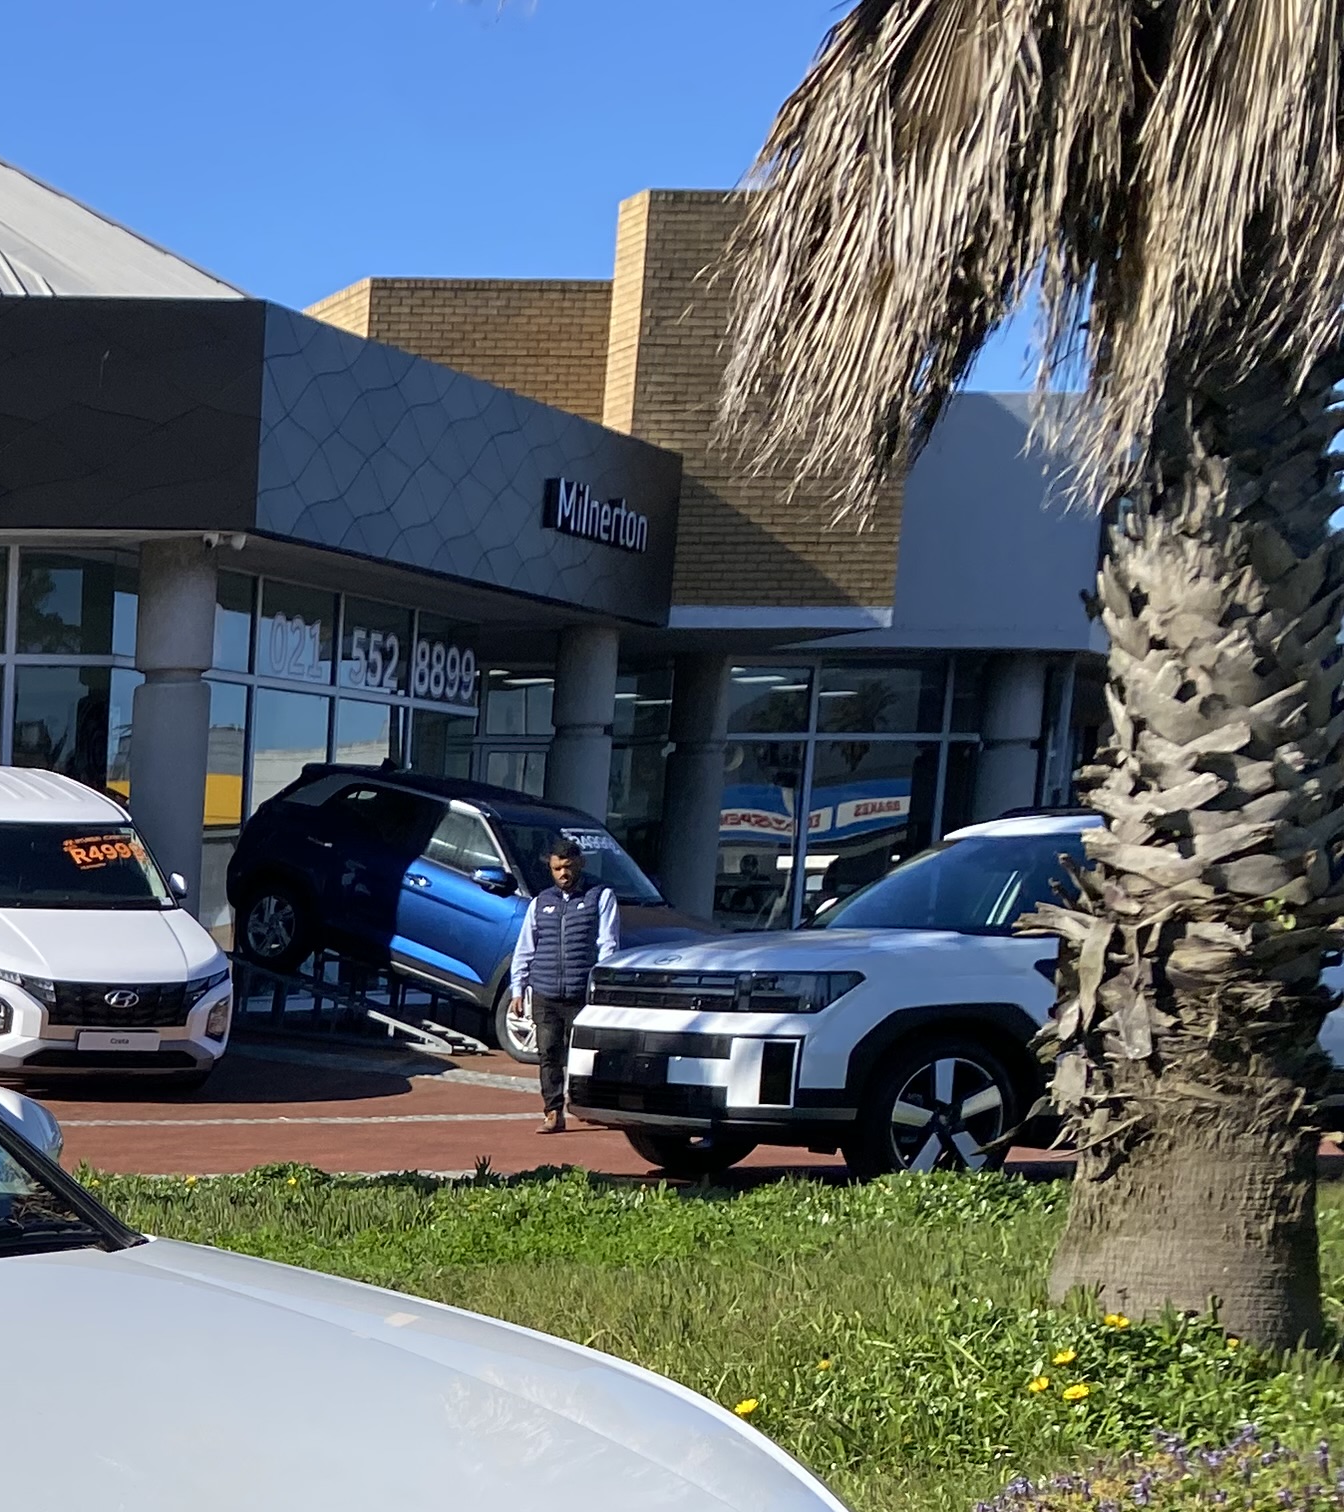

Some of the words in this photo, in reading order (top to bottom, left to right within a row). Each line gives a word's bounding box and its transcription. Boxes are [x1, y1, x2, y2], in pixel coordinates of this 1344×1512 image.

[556, 476, 649, 554] Milnerton
[269, 610, 324, 680] 021
[350, 626, 400, 690] 552
[413, 638, 476, 700] 8899
